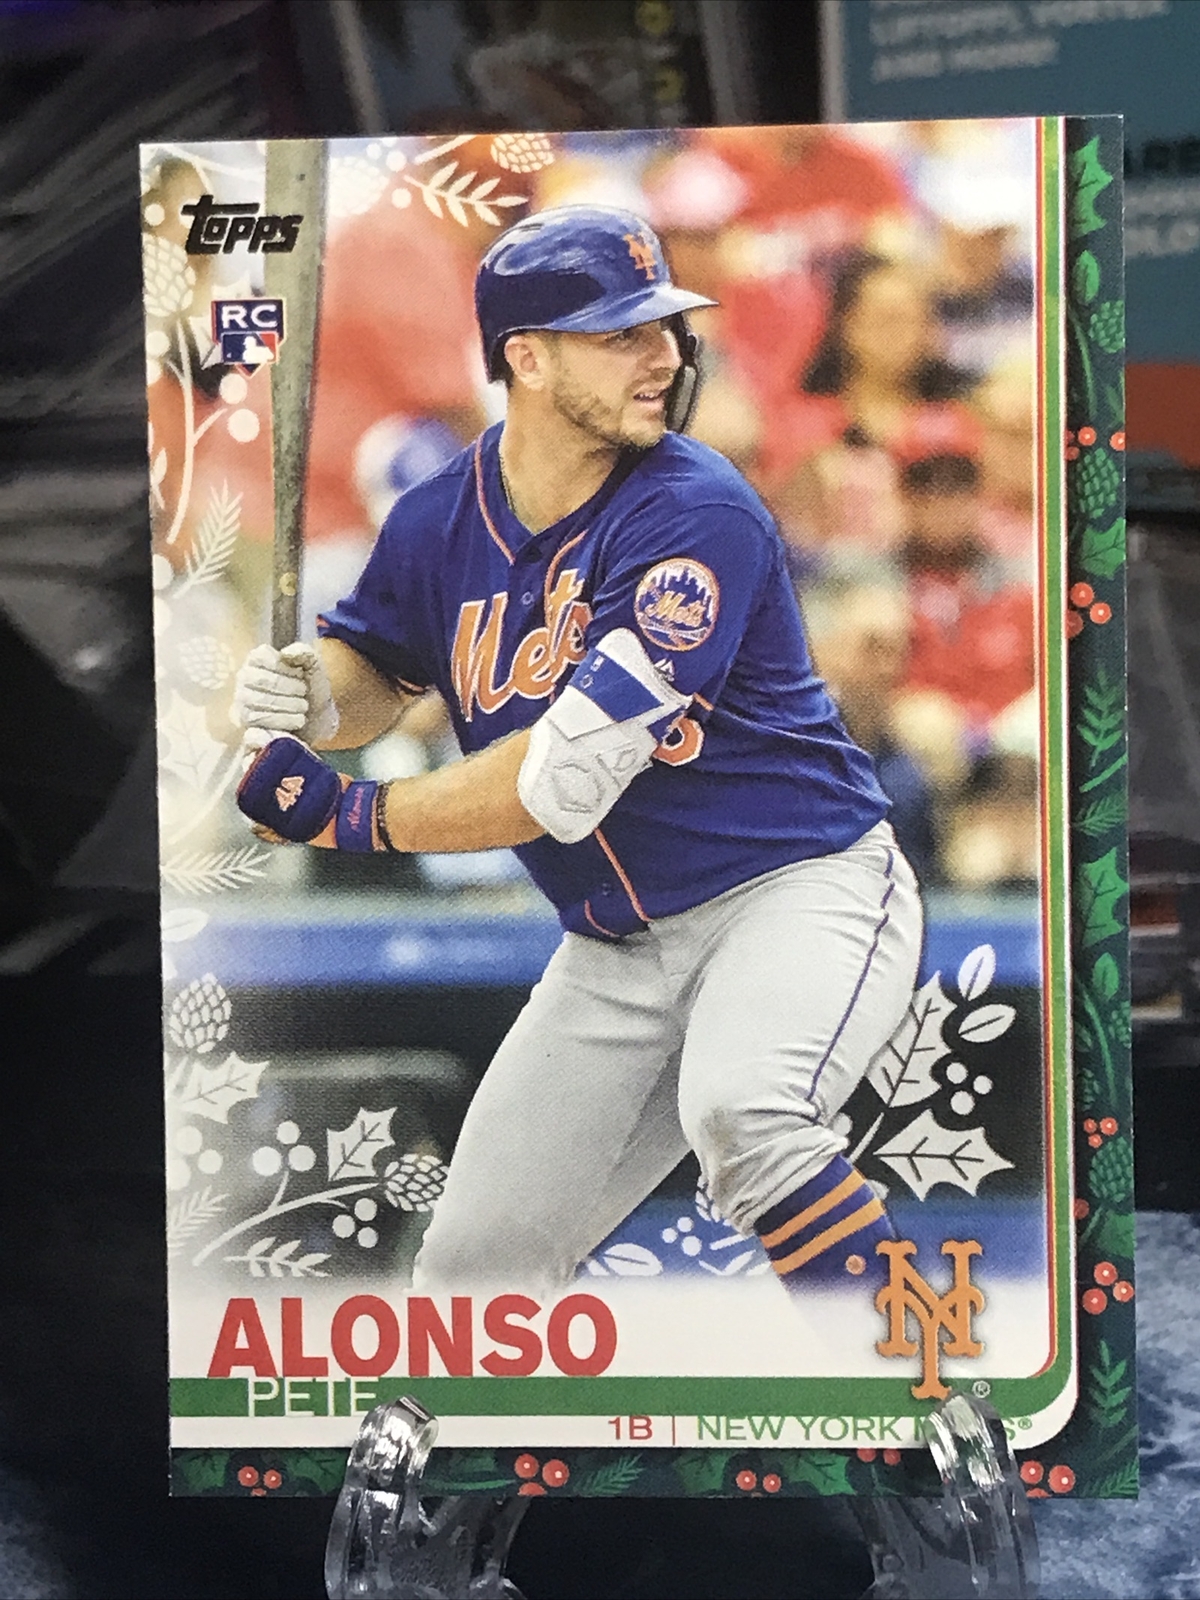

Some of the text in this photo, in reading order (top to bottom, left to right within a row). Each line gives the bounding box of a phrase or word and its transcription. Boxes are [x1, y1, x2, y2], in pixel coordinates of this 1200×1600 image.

[222, 304, 278, 329] RC
[451, 568, 594, 723] Mets
[207, 1293, 618, 1378] ALONSO
[248, 1377, 379, 1417] PETE
[608, 1416, 653, 1441] 1B
[698, 1415, 786, 1441] NEW
[797, 1415, 903, 1441] YORK
